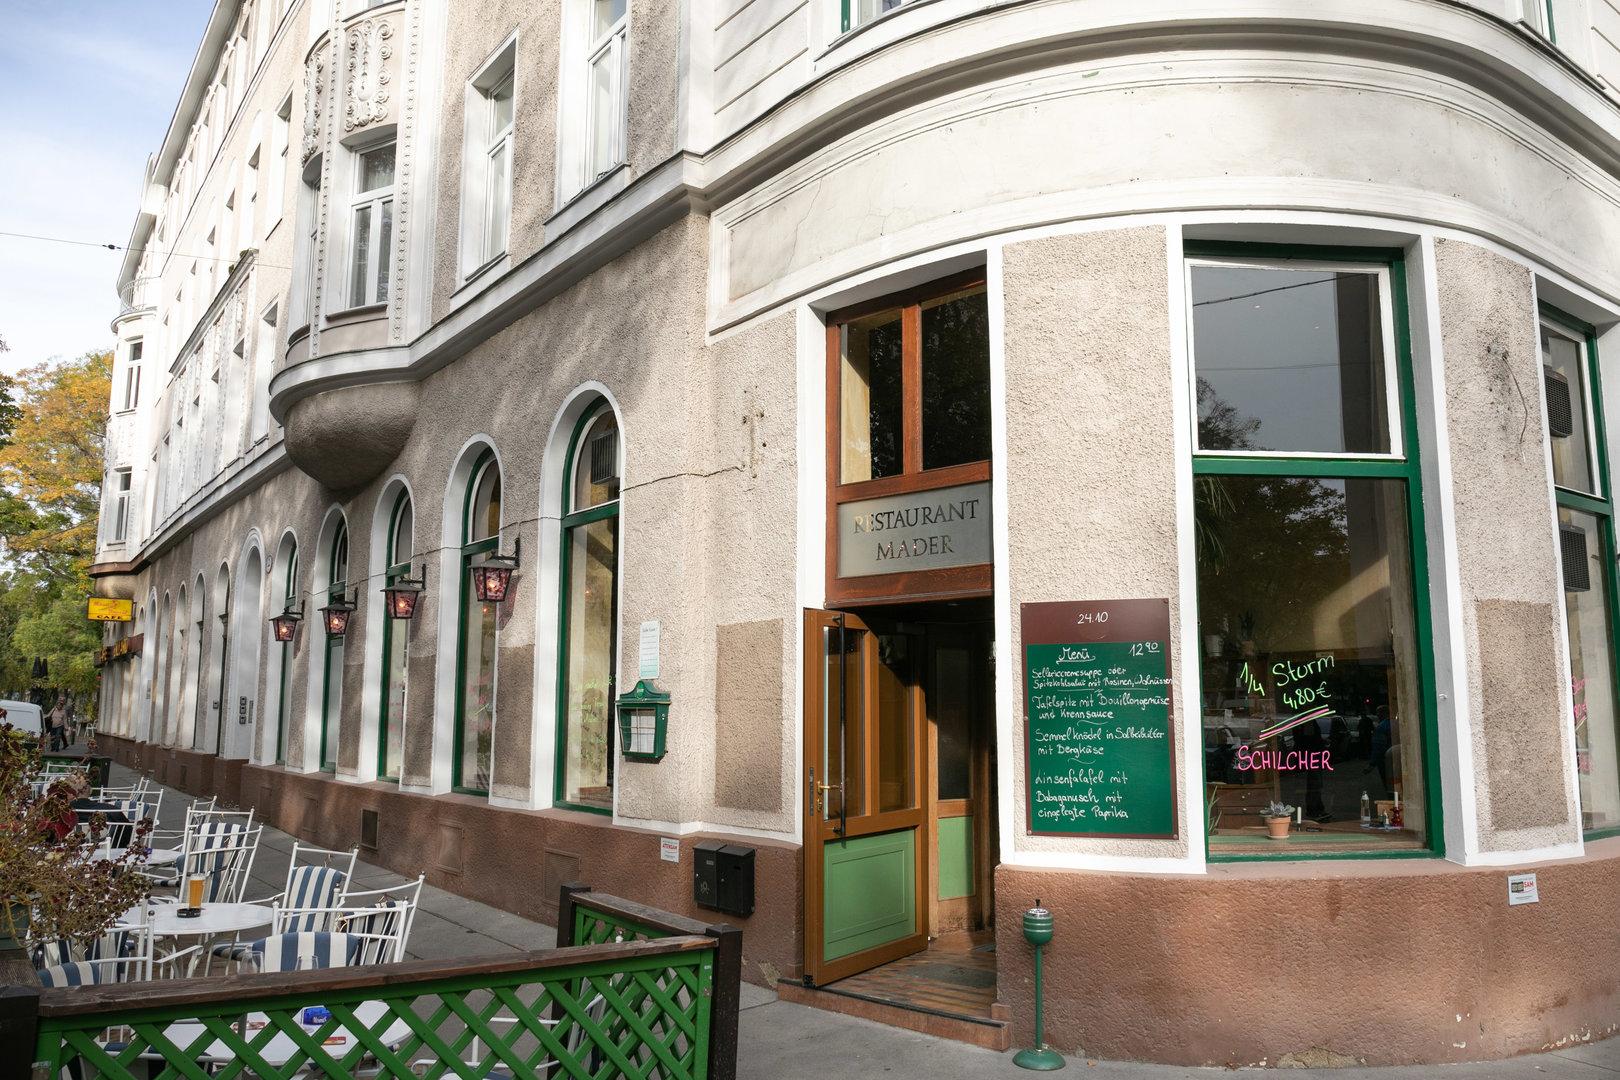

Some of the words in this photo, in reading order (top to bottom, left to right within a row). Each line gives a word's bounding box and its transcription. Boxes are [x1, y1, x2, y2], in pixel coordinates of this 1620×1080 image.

[853, 499, 979, 534] RESTAURANT
[876, 535, 954, 561] MADER
[1077, 611, 1109, 625] 24.10
[1057, 646, 1094, 662] Menü
[1108, 664, 1127, 675] oder
[1272, 655, 1335, 687] Sturm
[1088, 676, 1101, 688] mit
[1032, 694, 1077, 710] Tafelspitz
[1079, 693, 1094, 708] mit
[1039, 710, 1056, 720] und
[1106, 727, 1115, 740] in
[1037, 746, 1053, 756] mit
[1057, 743, 1104, 758] Bergkäse
[1035, 768, 1104, 787] Linsenfalafel
[1110, 771, 1128, 785] mit
[1105, 790, 1123, 804] mit
[1091, 805, 1129, 821] Paprika
